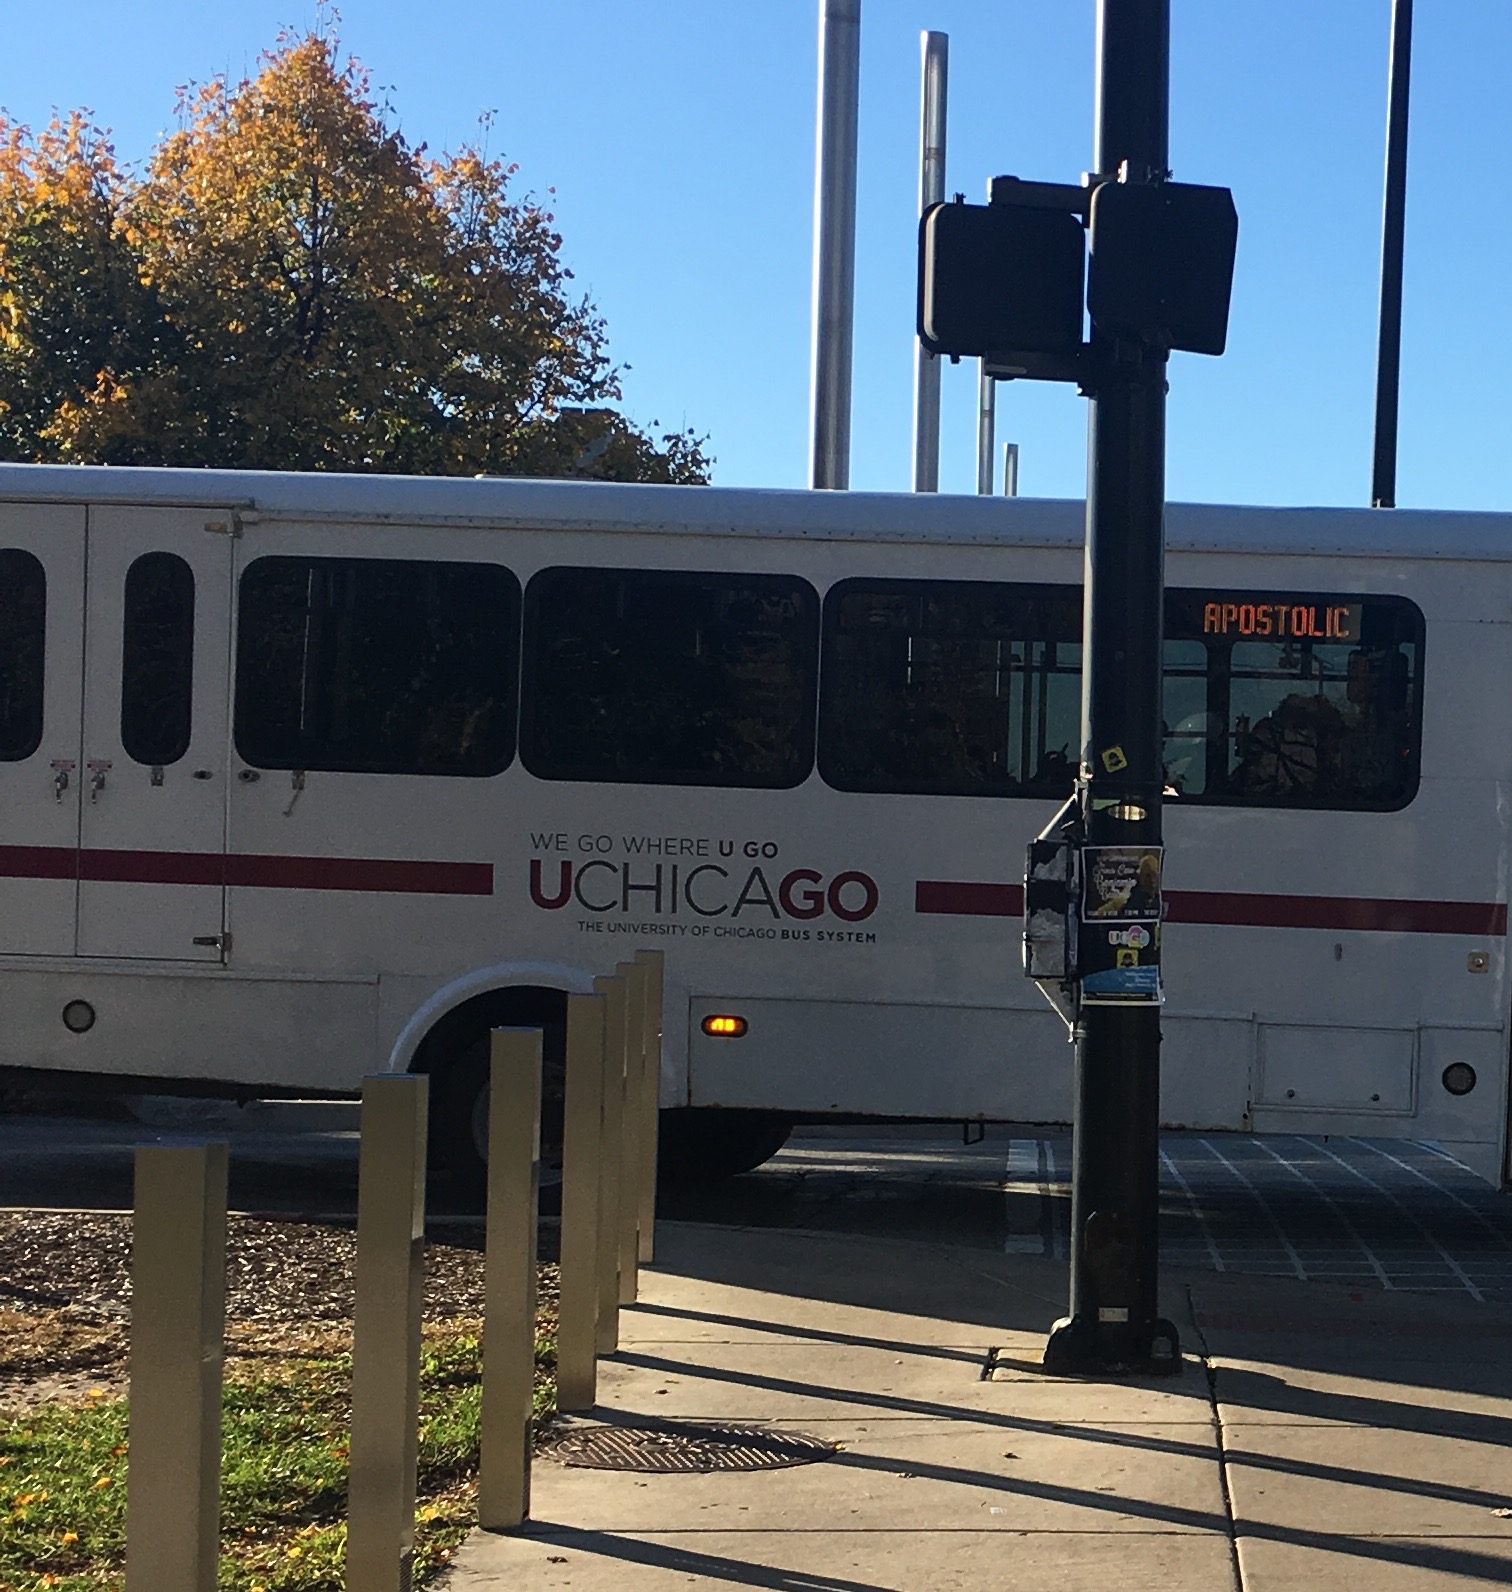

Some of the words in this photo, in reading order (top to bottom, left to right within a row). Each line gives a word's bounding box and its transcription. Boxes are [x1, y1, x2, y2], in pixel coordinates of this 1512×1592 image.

[1203, 603, 1350, 638] APOSTOLIC
[530, 832, 568, 851] WE
[577, 834, 613, 853] GO
[622, 836, 709, 857] WHERE
[718, 840, 734, 857] U
[743, 841, 778, 859] GO
[529, 859, 880, 922] UCHICAGO
[577, 920, 603, 933] THE
[607, 922, 688, 936] UNIVERSITY
[691, 925, 710, 937] OF
[714, 926, 776, 940] CHICAGO
[780, 929, 810, 941] BUS
[817, 930, 876, 943] SYSTEM
